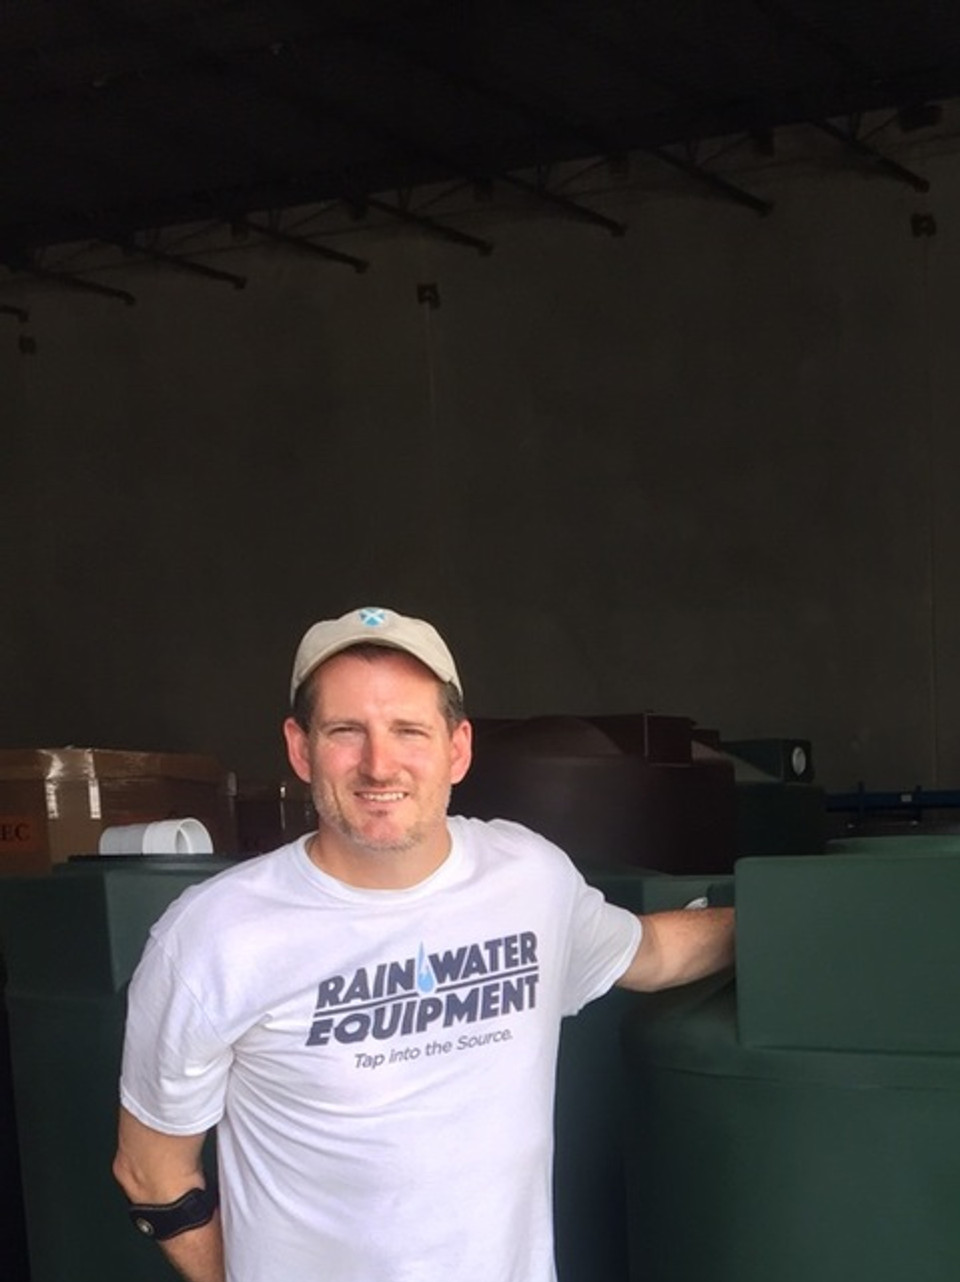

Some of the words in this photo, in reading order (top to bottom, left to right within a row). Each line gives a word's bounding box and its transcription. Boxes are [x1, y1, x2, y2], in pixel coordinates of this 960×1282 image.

[305, 973, 540, 1047] EQUIPMENT
[354, 1053, 385, 1070] Tap
[389, 1045, 420, 1062] into
[425, 1037, 452, 1056] the
[457, 1028, 514, 1050] Source.
